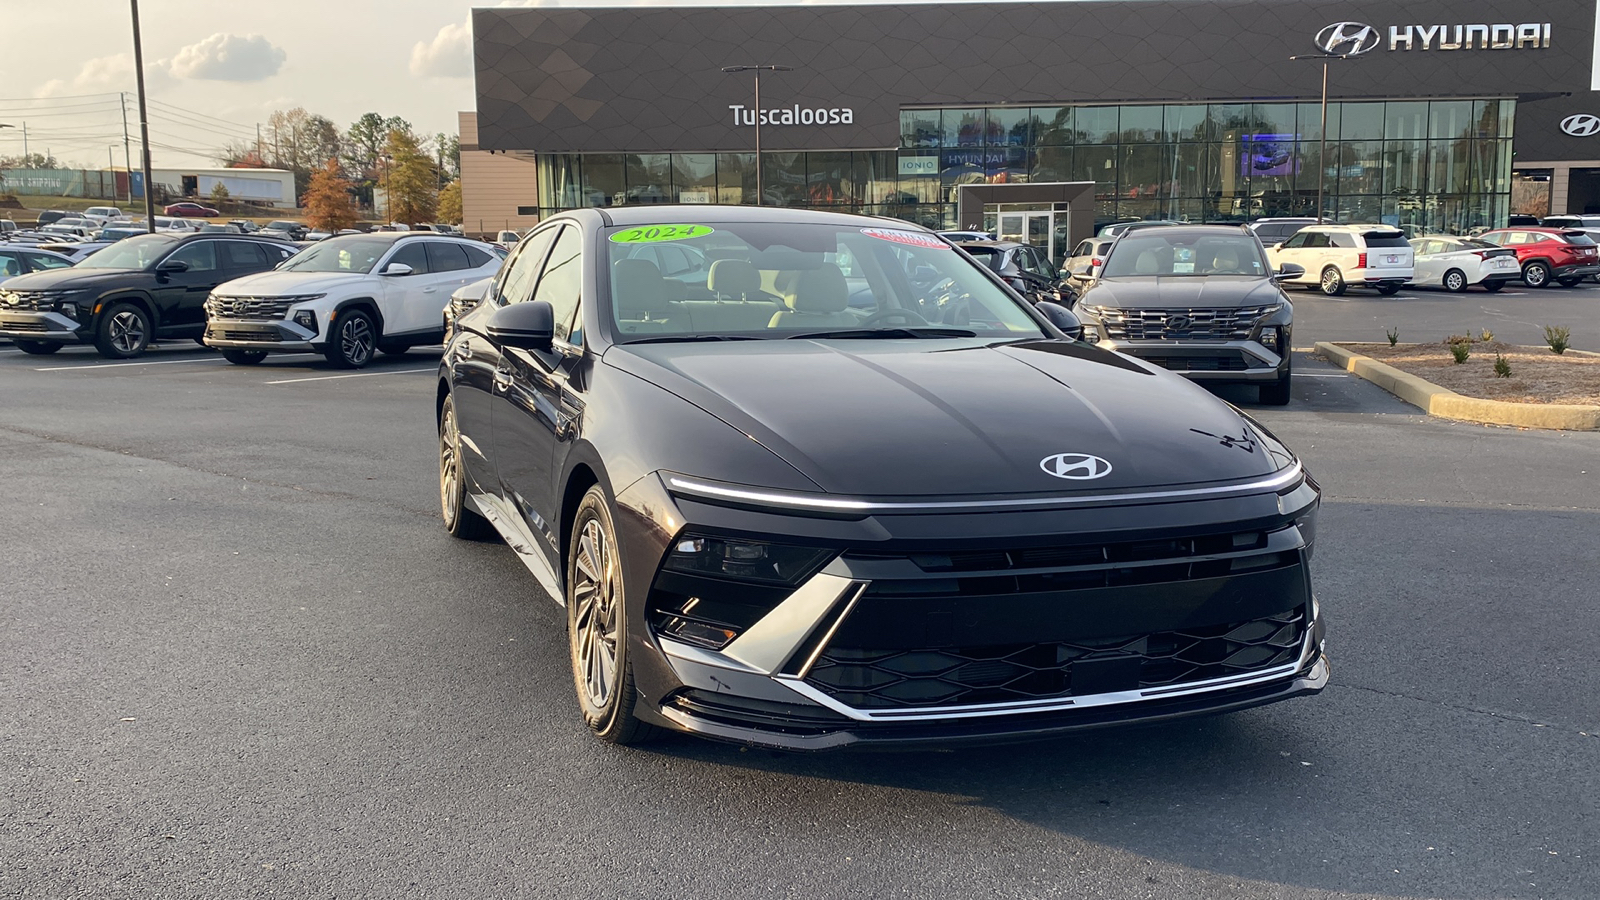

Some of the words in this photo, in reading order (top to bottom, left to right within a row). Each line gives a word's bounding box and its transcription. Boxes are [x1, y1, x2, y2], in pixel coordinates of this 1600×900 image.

[1388, 23, 1551, 50] HYUNDAI
[728, 104, 853, 125] Tuscaloosa
[626, 225, 696, 242] 2024
